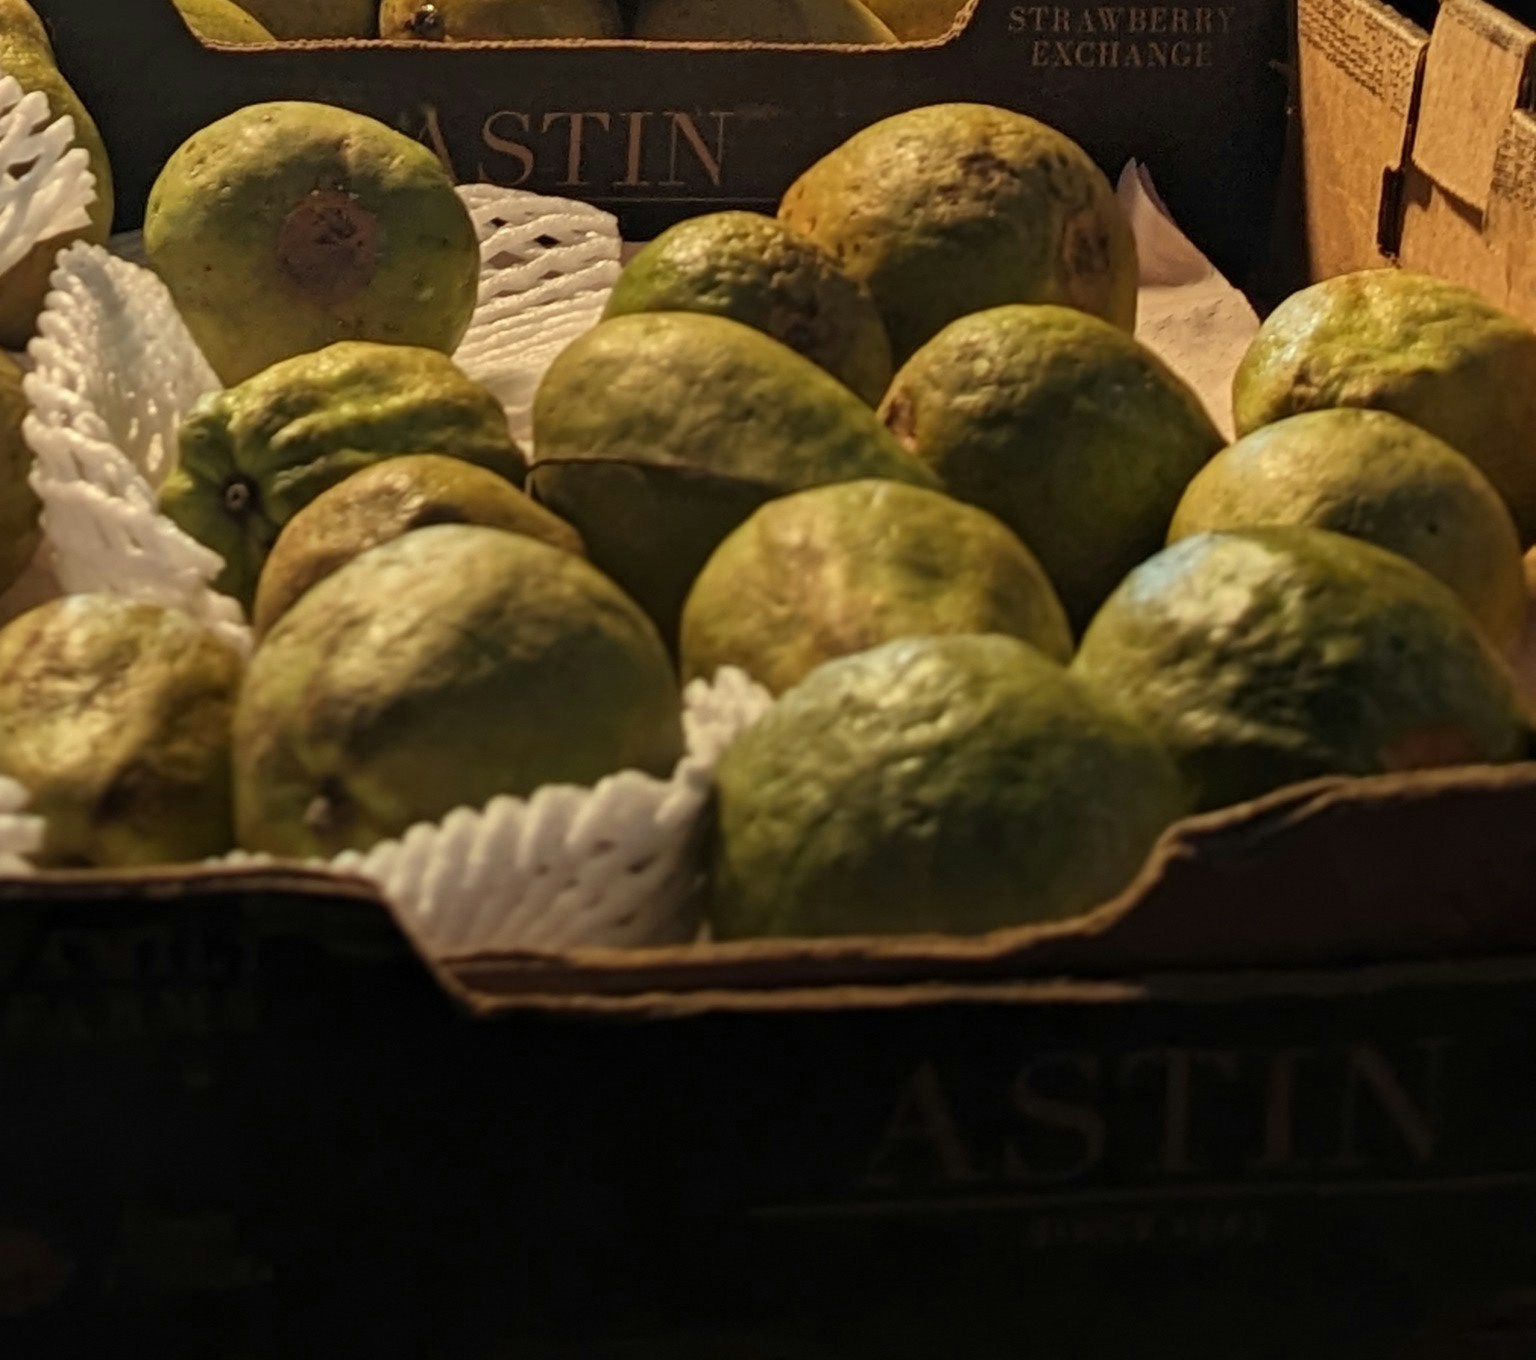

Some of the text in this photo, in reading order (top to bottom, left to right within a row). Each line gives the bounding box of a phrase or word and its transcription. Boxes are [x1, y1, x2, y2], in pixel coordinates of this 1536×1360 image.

[1006, 3, 1237, 36] STRAWBERRY
[1030, 38, 1215, 69] EXCHANGE
[852, 1034, 1457, 1191] ASTIN
